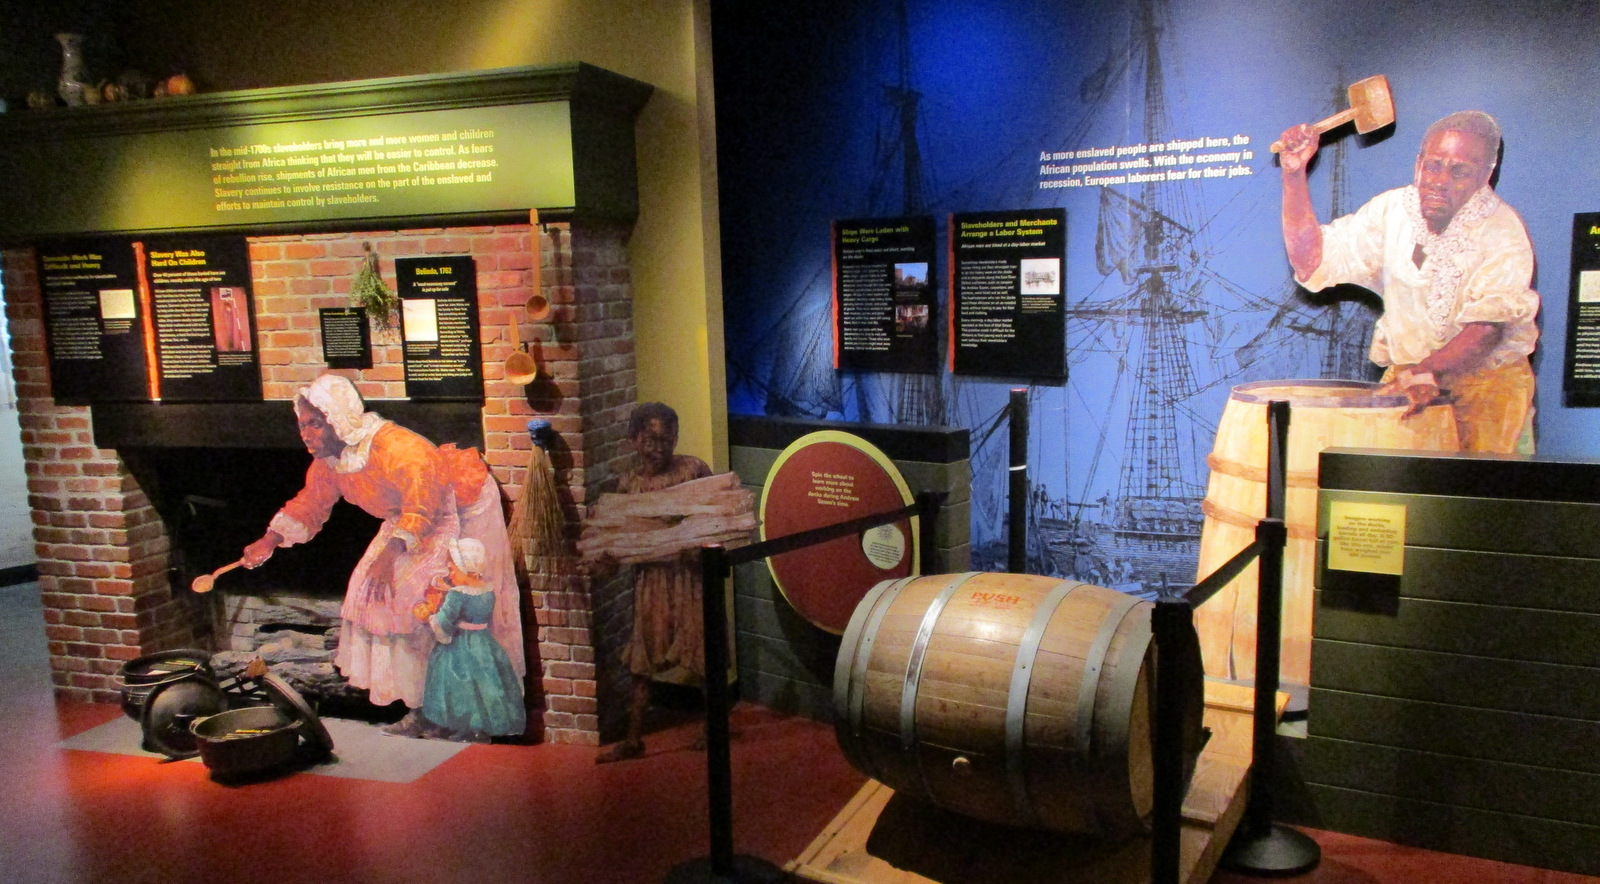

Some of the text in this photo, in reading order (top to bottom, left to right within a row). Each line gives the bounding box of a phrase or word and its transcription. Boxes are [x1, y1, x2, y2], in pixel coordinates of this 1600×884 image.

[211, 129, 494, 157] In the mid-1700s slaveholders bring more and more women and children
[1040, 134, 1249, 161] As more enslaved people are shipped here, the
[211, 144, 493, 172] straight from Africa thinking that they will be easier to control. As fears
[213, 158, 498, 184] of rebellion rise, shipments of African men from the Caribbean decrease.
[1040, 149, 1253, 175] African population swells. With the economy in
[215, 172, 491, 198] Slavery continues to involve resistance on the part of the enslaved and
[1040, 165, 1253, 188] recession, European laborers fear for their jobs.
[216, 193, 379, 211] efforts to maintain control by slaveholders.
[961, 221, 1003, 229] Slaveholders
[1020, 219, 1057, 227] Merchants
[1017, 228, 1042, 236] System
[970, 592, 1020, 604] PUSH
